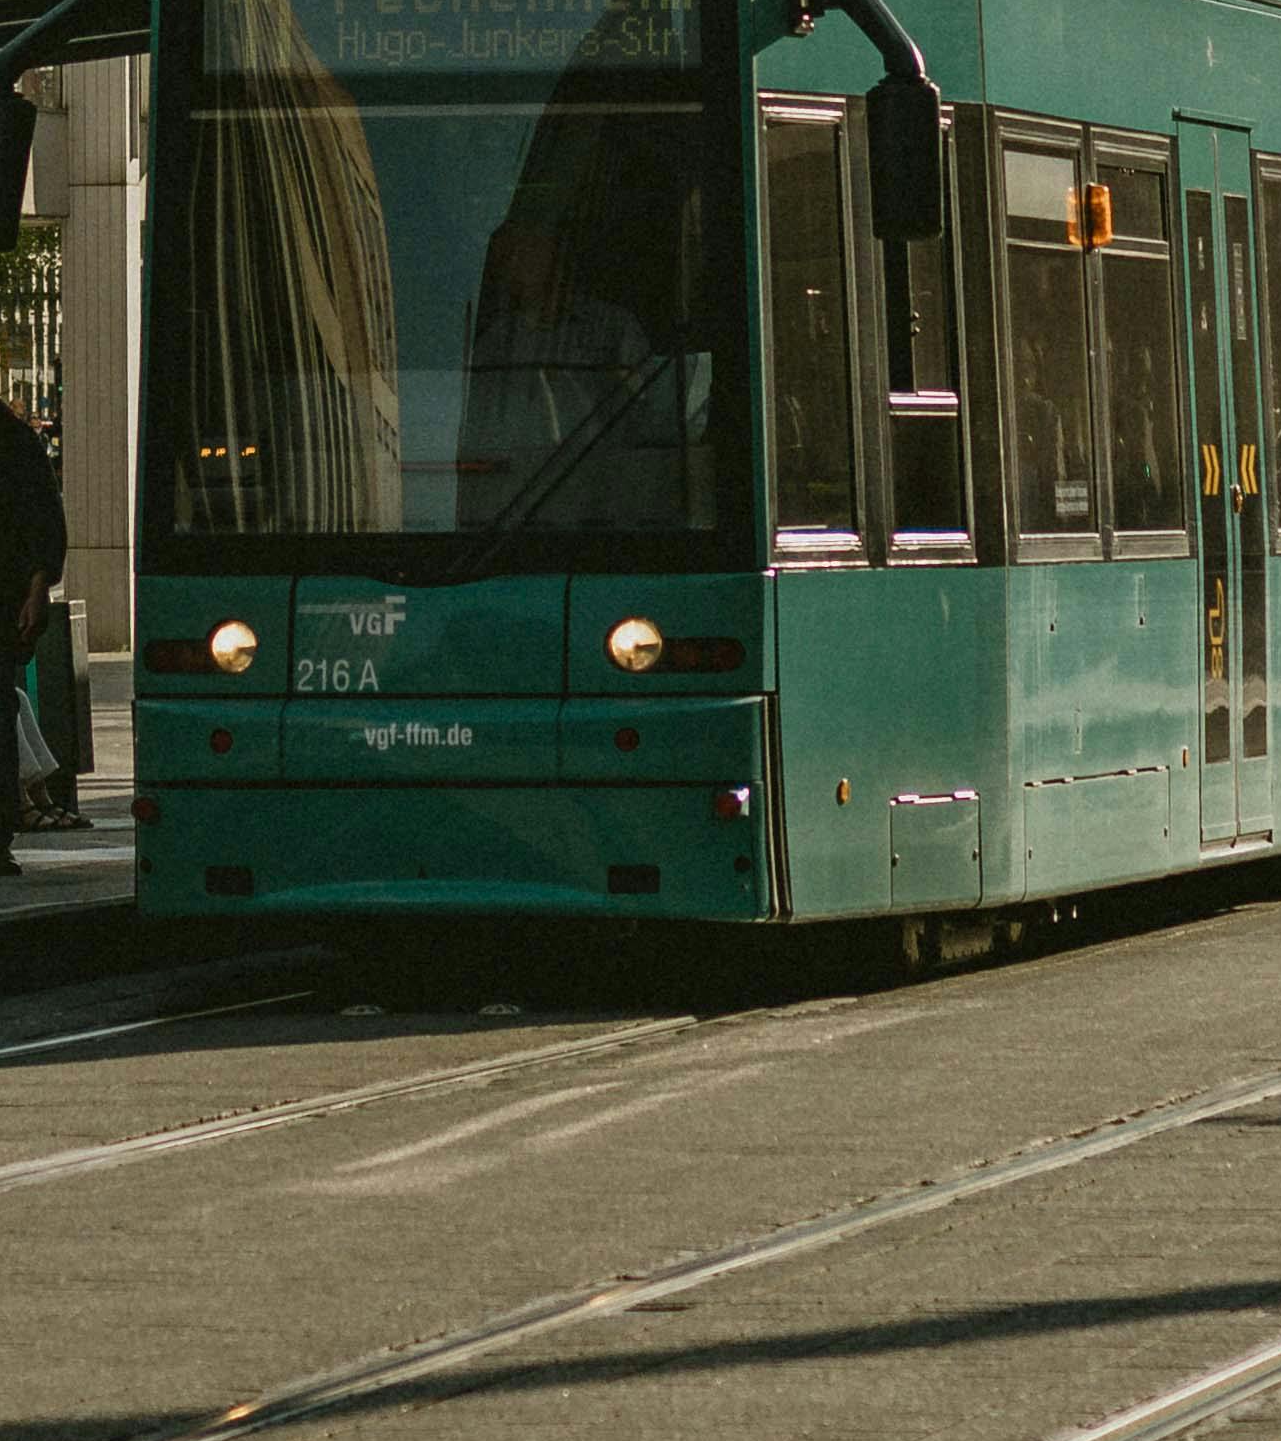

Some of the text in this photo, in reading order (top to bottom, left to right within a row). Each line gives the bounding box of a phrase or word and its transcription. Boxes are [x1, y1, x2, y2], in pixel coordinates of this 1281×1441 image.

[350, 596, 406, 635] VGF
[297, 659, 379, 691] 216 A
[365, 722, 473, 750] vgf-ffm.de
